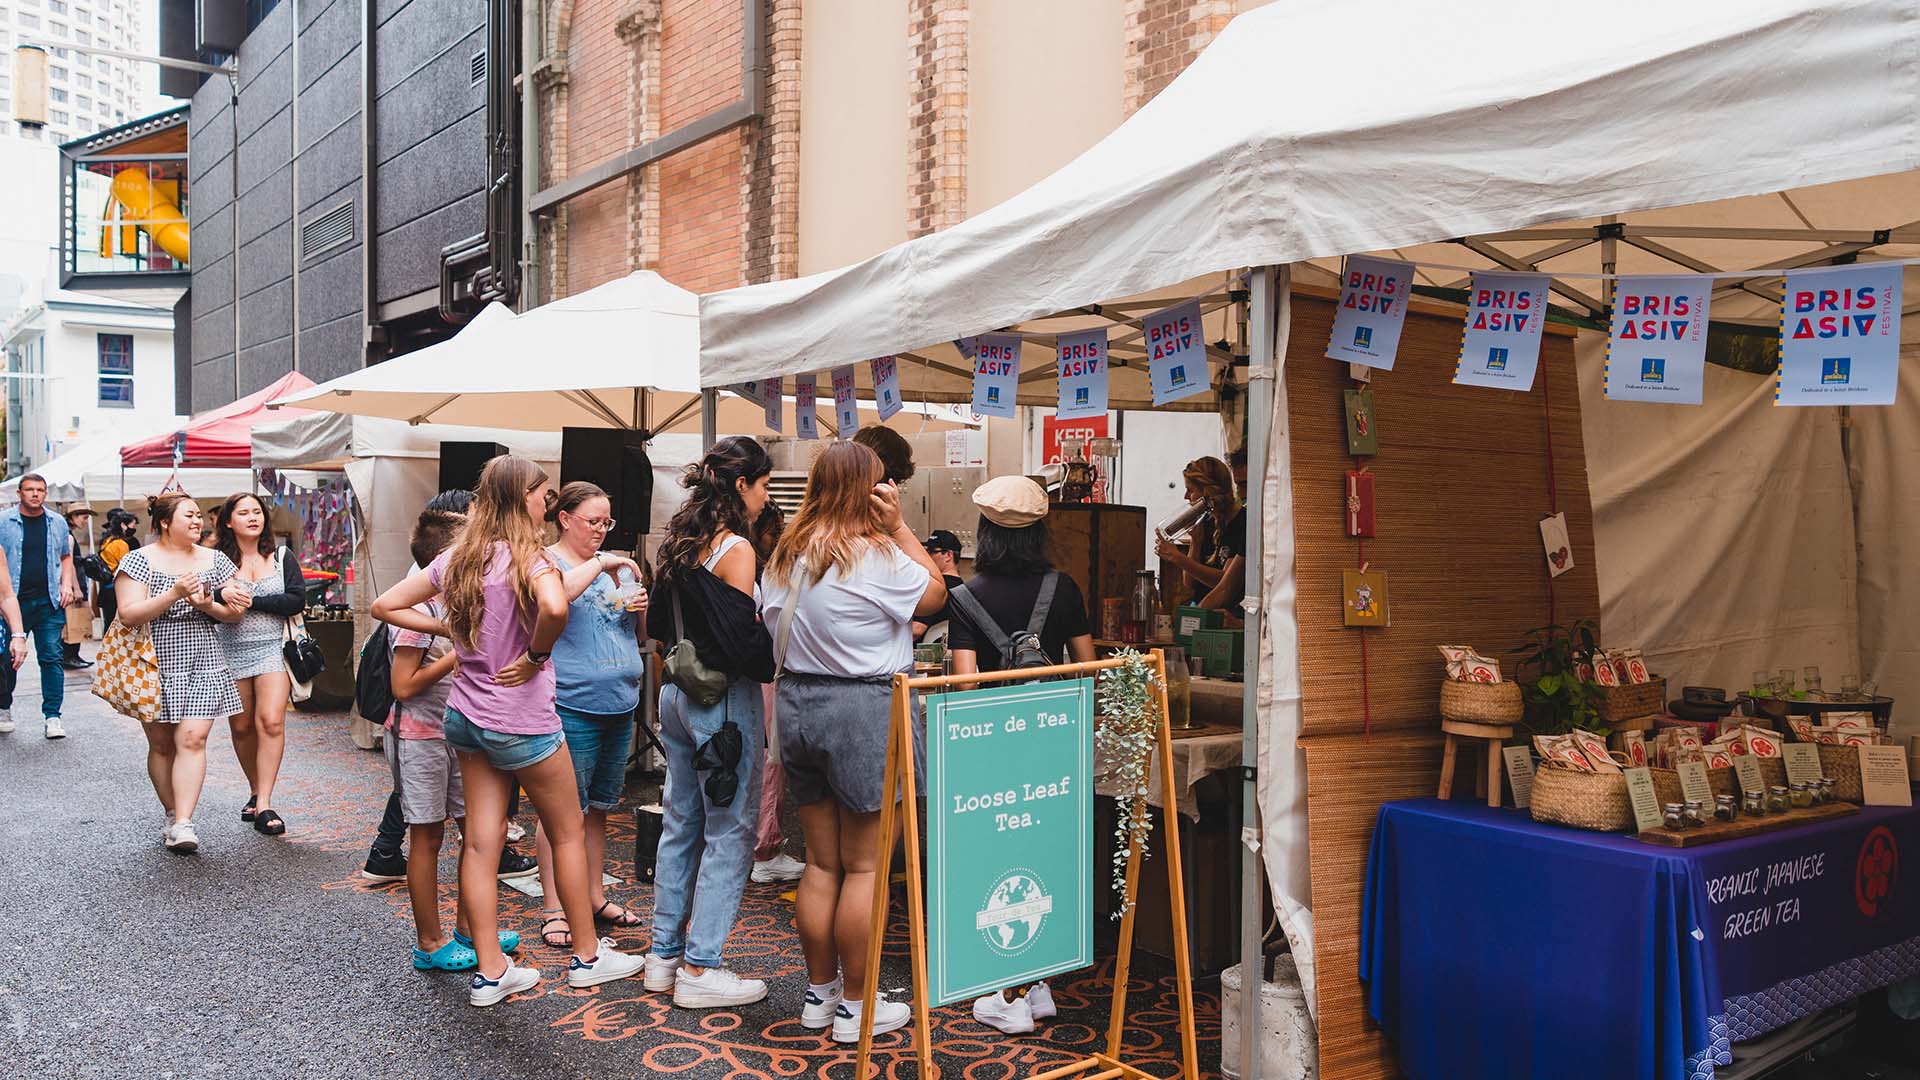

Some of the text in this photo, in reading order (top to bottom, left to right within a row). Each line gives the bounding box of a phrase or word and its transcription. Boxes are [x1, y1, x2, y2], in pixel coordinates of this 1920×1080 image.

[1349, 272, 1396, 295] BRIS
[1477, 289, 1531, 310] BRIS
[1623, 296, 1689, 316] BRIS
[1796, 287, 1876, 313] BRIS
[1882, 285, 1893, 336] FESTIVAL
[1150, 316, 1190, 343] BRIS
[1692, 295, 1703, 342] FESTIVAL
[981, 344, 1012, 360] BRIS
[1062, 342, 1097, 360] BRIS
[1055, 427, 1095, 447] KEEP
[948, 711, 1076, 740] Tour de Tea.
[953, 776, 1071, 814] Loose Leaf
[995, 811, 1041, 832] Tea.
[1706, 852, 1825, 904] RGANIC JAPANESE
[1723, 897, 1800, 940] GREEN TEA
